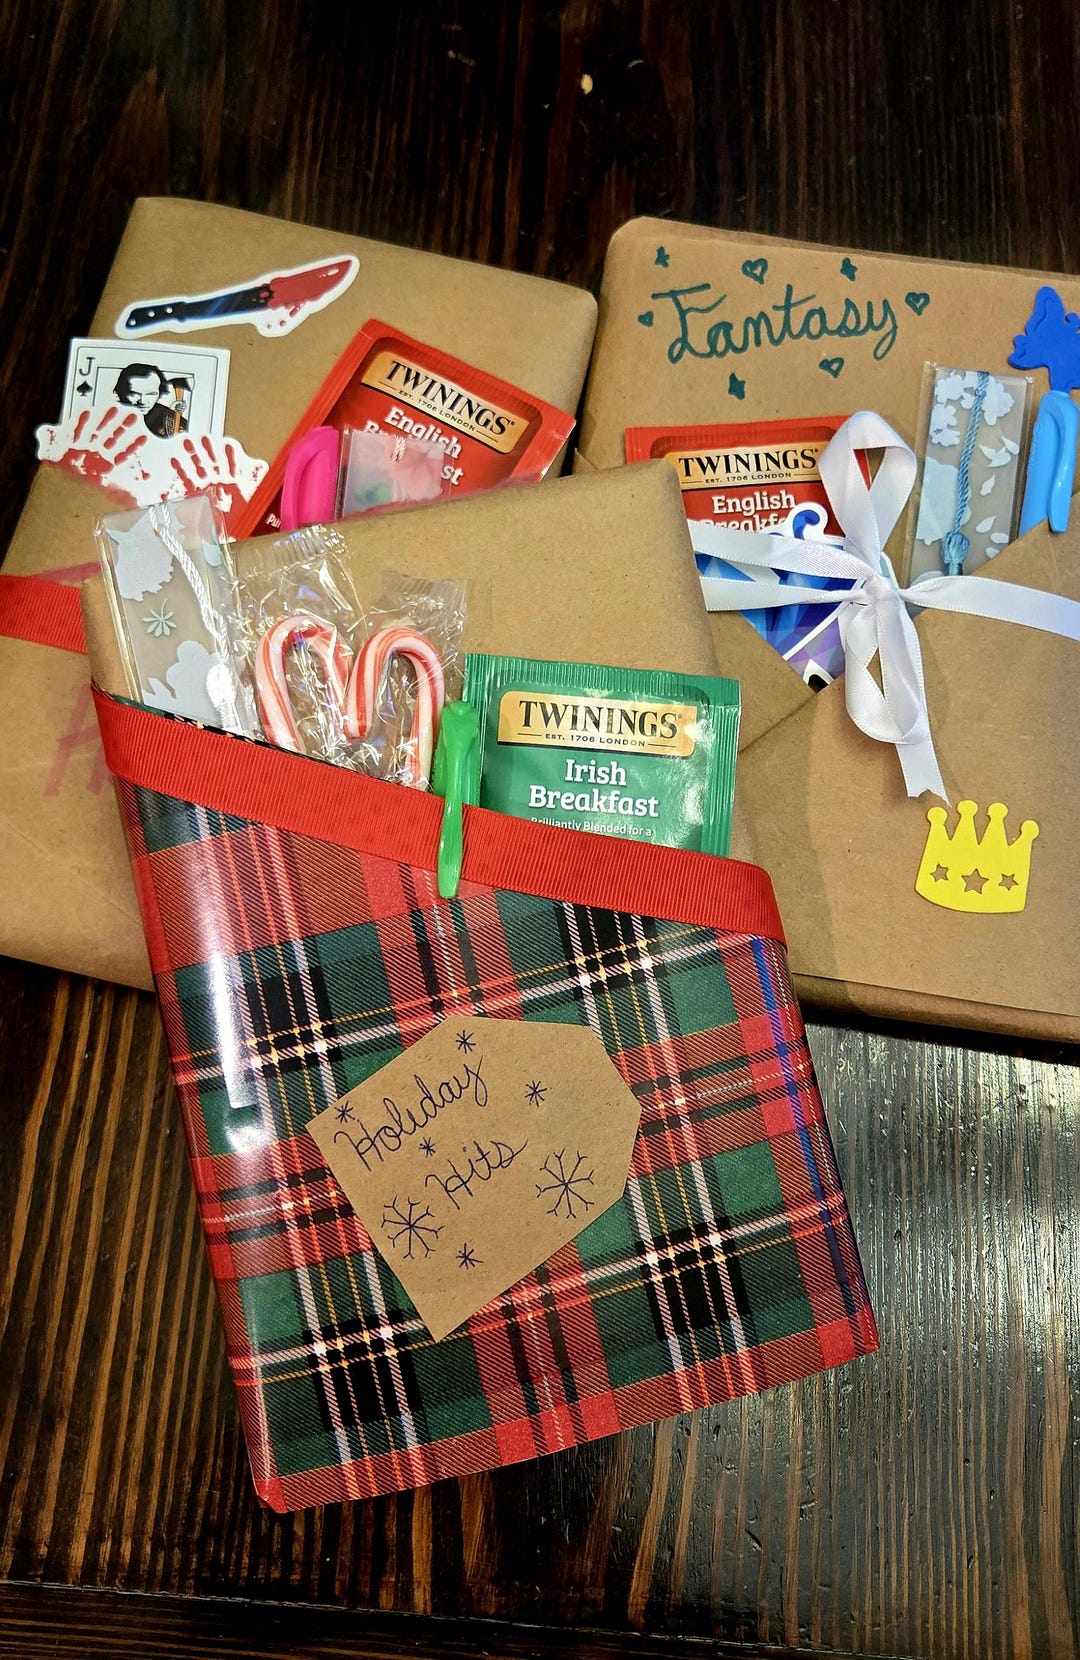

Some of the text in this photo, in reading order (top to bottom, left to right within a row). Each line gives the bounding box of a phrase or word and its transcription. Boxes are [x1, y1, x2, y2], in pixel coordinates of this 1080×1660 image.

[651, 283, 899, 365] Fantasy
[78, 356, 96, 377] J
[386, 360, 513, 436] TWININGS
[398, 389, 477, 432] EST. 1706 LONDON
[678, 448, 818, 477] TWININGS
[726, 474, 748, 482] 1706
[751, 471, 792, 481] LONDON
[711, 489, 797, 517] English
[519, 700, 680, 740] TWININGS
[545, 733, 646, 747] EST. 1706 LONDON
[564, 758, 627, 786] Irish
[528, 784, 659, 817] Breakfast
[583, 821, 627, 834] Blended
[628, 824, 643, 836] for
[645, 828, 652, 836] a
[334, 1054, 488, 1172] Holiday
[425, 1138, 529, 1210] Hits
